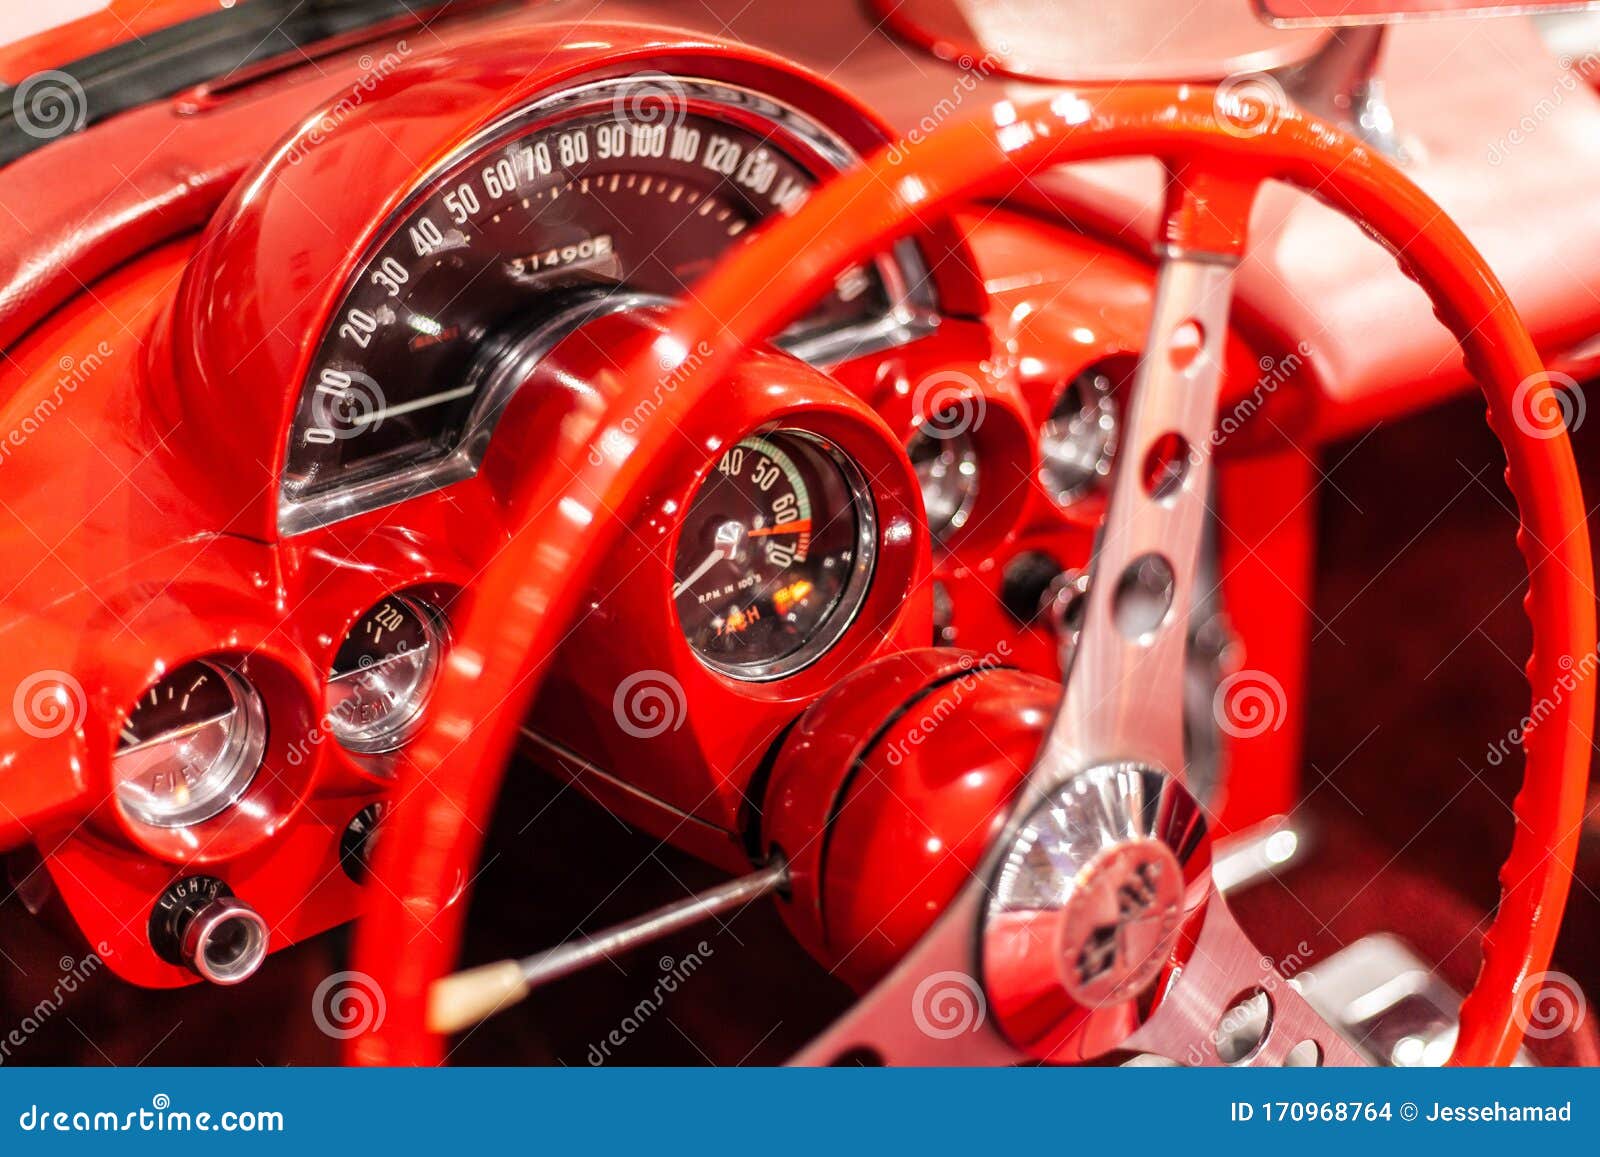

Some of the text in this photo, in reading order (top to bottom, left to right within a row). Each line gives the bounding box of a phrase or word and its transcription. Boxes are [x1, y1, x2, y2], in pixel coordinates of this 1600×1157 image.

[559, 131, 589, 167] 80
[597, 125, 626, 159] 90
[629, 124, 667, 158] 100
[669, 126, 701, 162] 110
[702, 135, 742, 175] 120
[482, 159, 517, 199] 60
[523, 142, 551, 181] 70
[443, 183, 480, 224] 50
[409, 217, 444, 256] 40
[371, 257, 409, 296] 30
[339, 308, 377, 349] 20
[316, 368, 352, 398] 10
[304, 428, 335, 444] 0
[719, 448, 744, 476] 40
[751, 456, 780, 491] 50
[772, 492, 798, 525] 60
[768, 541, 797, 568] 70
[374, 603, 404, 632] 220
